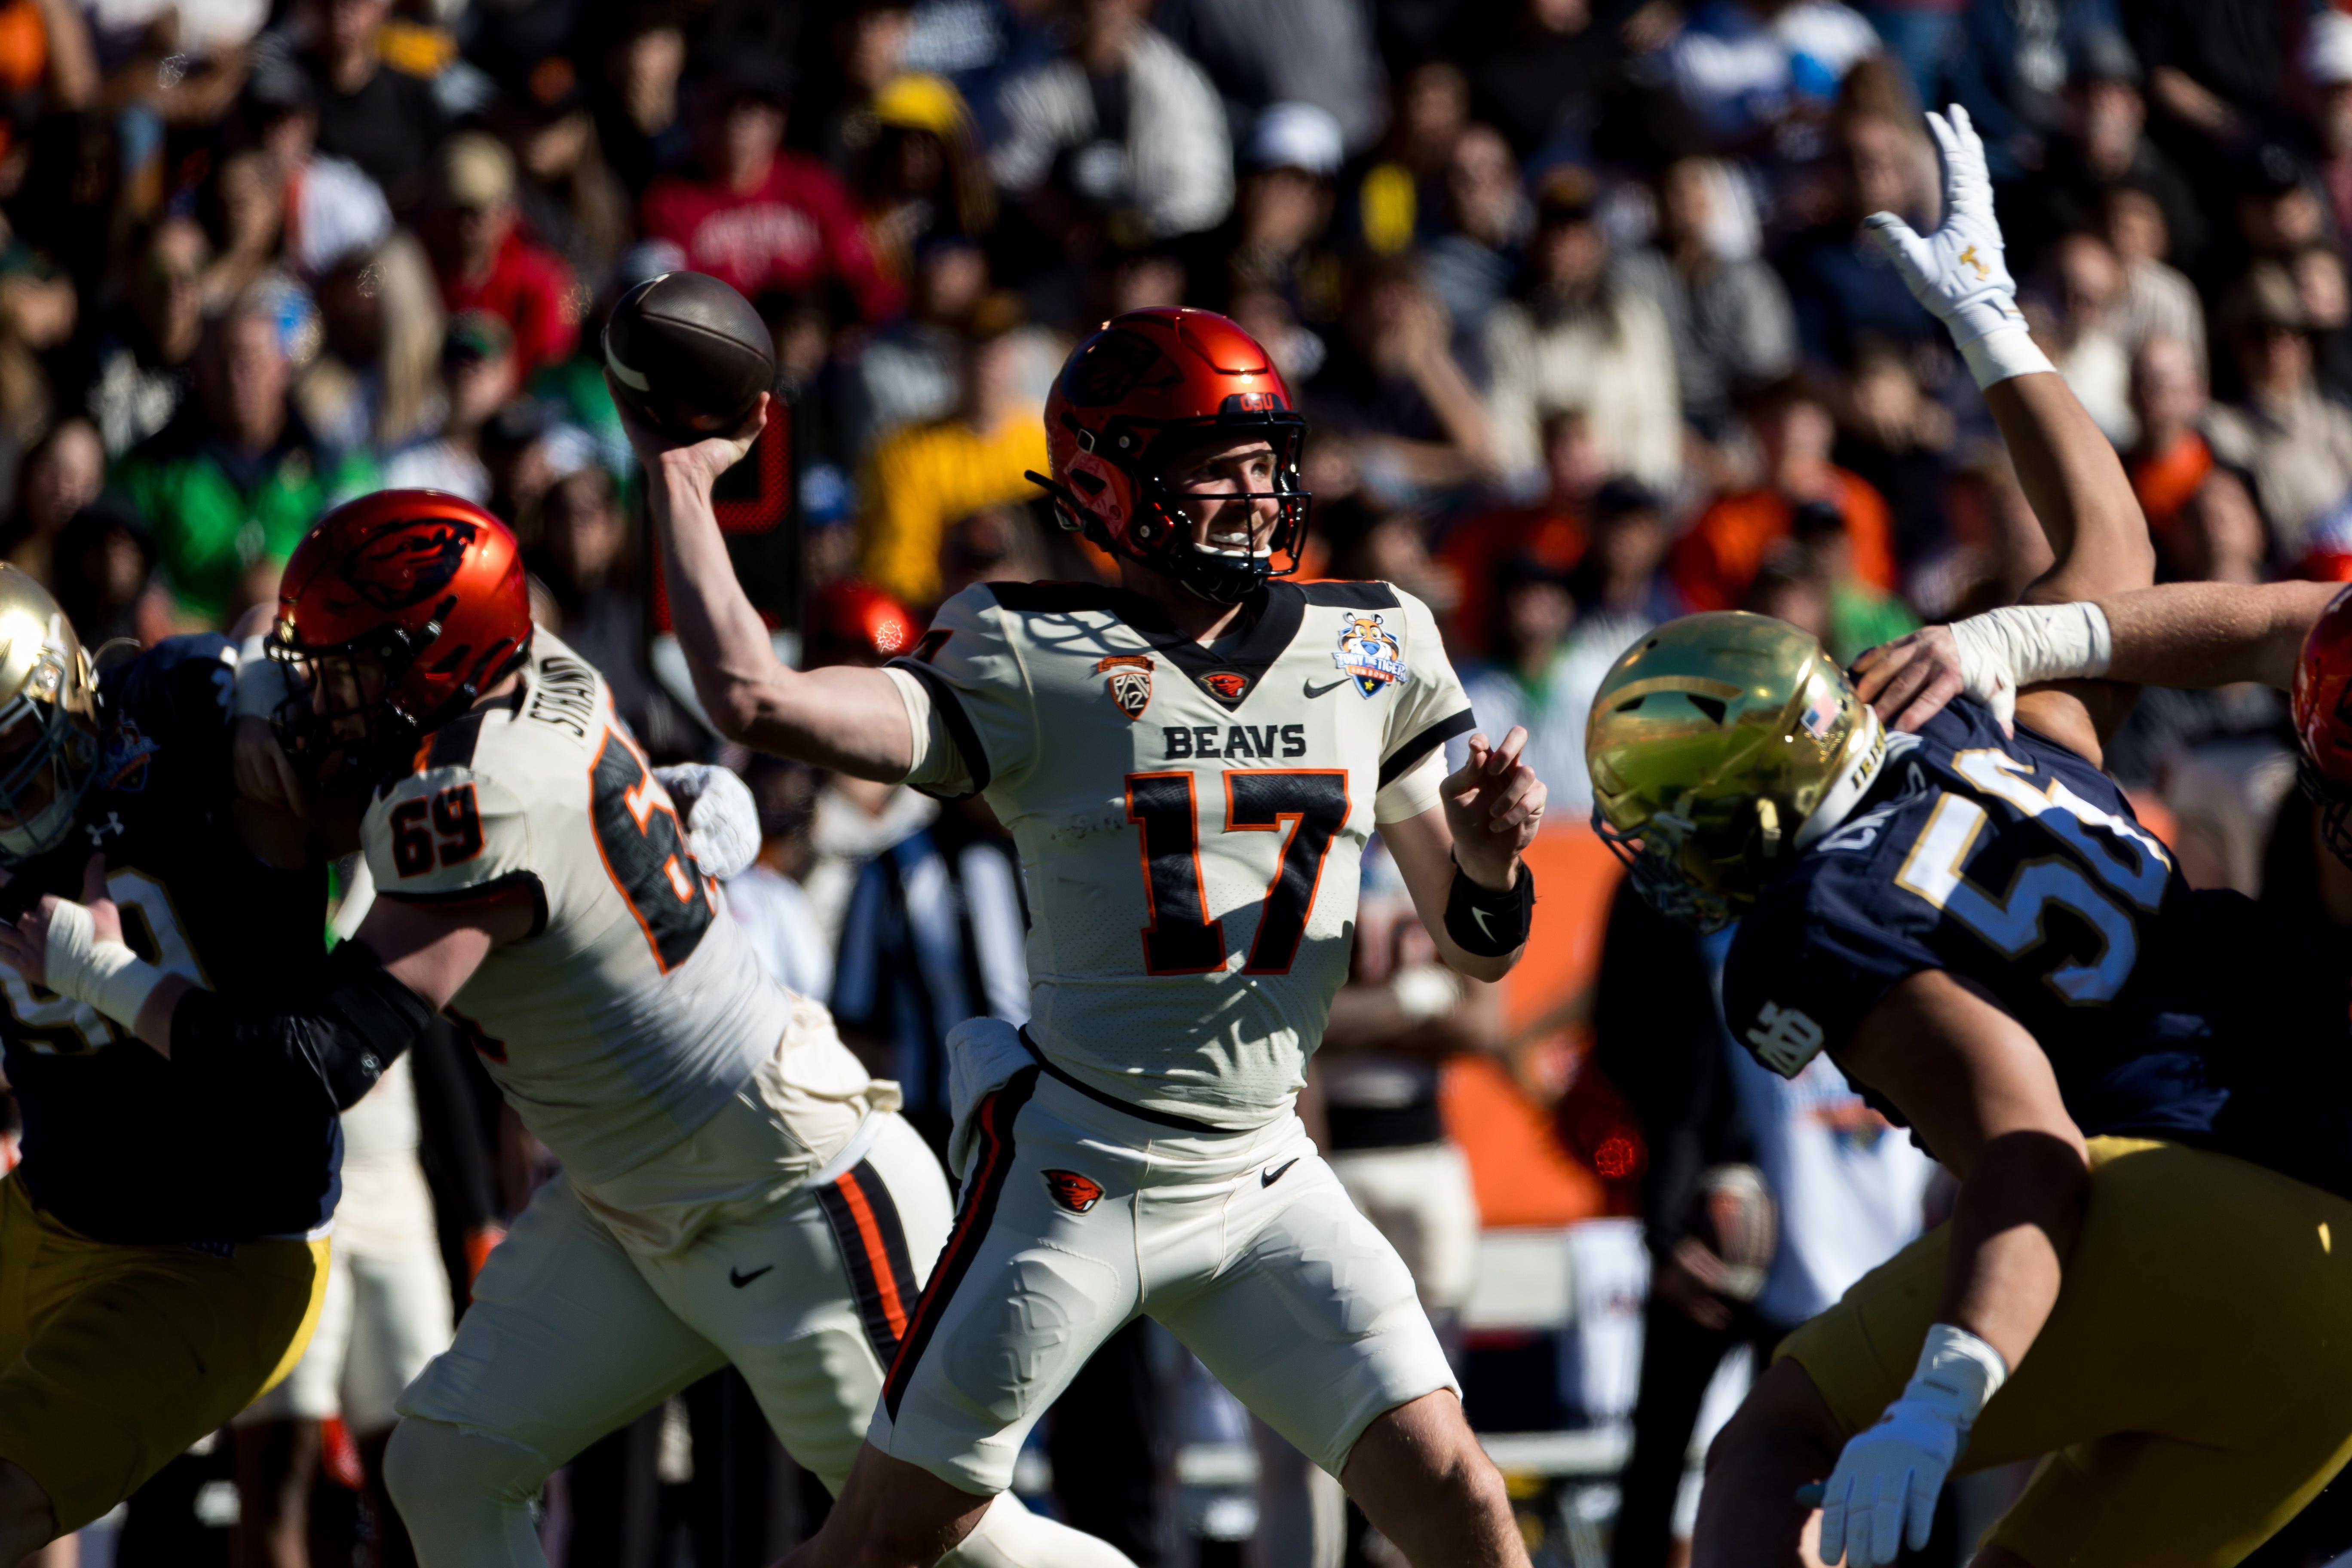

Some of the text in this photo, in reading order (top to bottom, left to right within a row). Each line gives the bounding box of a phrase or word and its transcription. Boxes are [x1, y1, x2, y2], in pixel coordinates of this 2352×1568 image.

[1240, 392, 1274, 412] OSU
[1335, 653, 1407, 679] TONY THE TIGER
[1368, 670, 1390, 681] BOWL
[528, 656, 595, 738] STRAND
[1112, 674, 1150, 702] PAC
[1124, 691, 1145, 710] 12
[1163, 723, 1307, 759] BEAVS
[390, 780, 486, 880] 69
[588, 724, 717, 976] 6
[1125, 769, 1352, 976] 17
